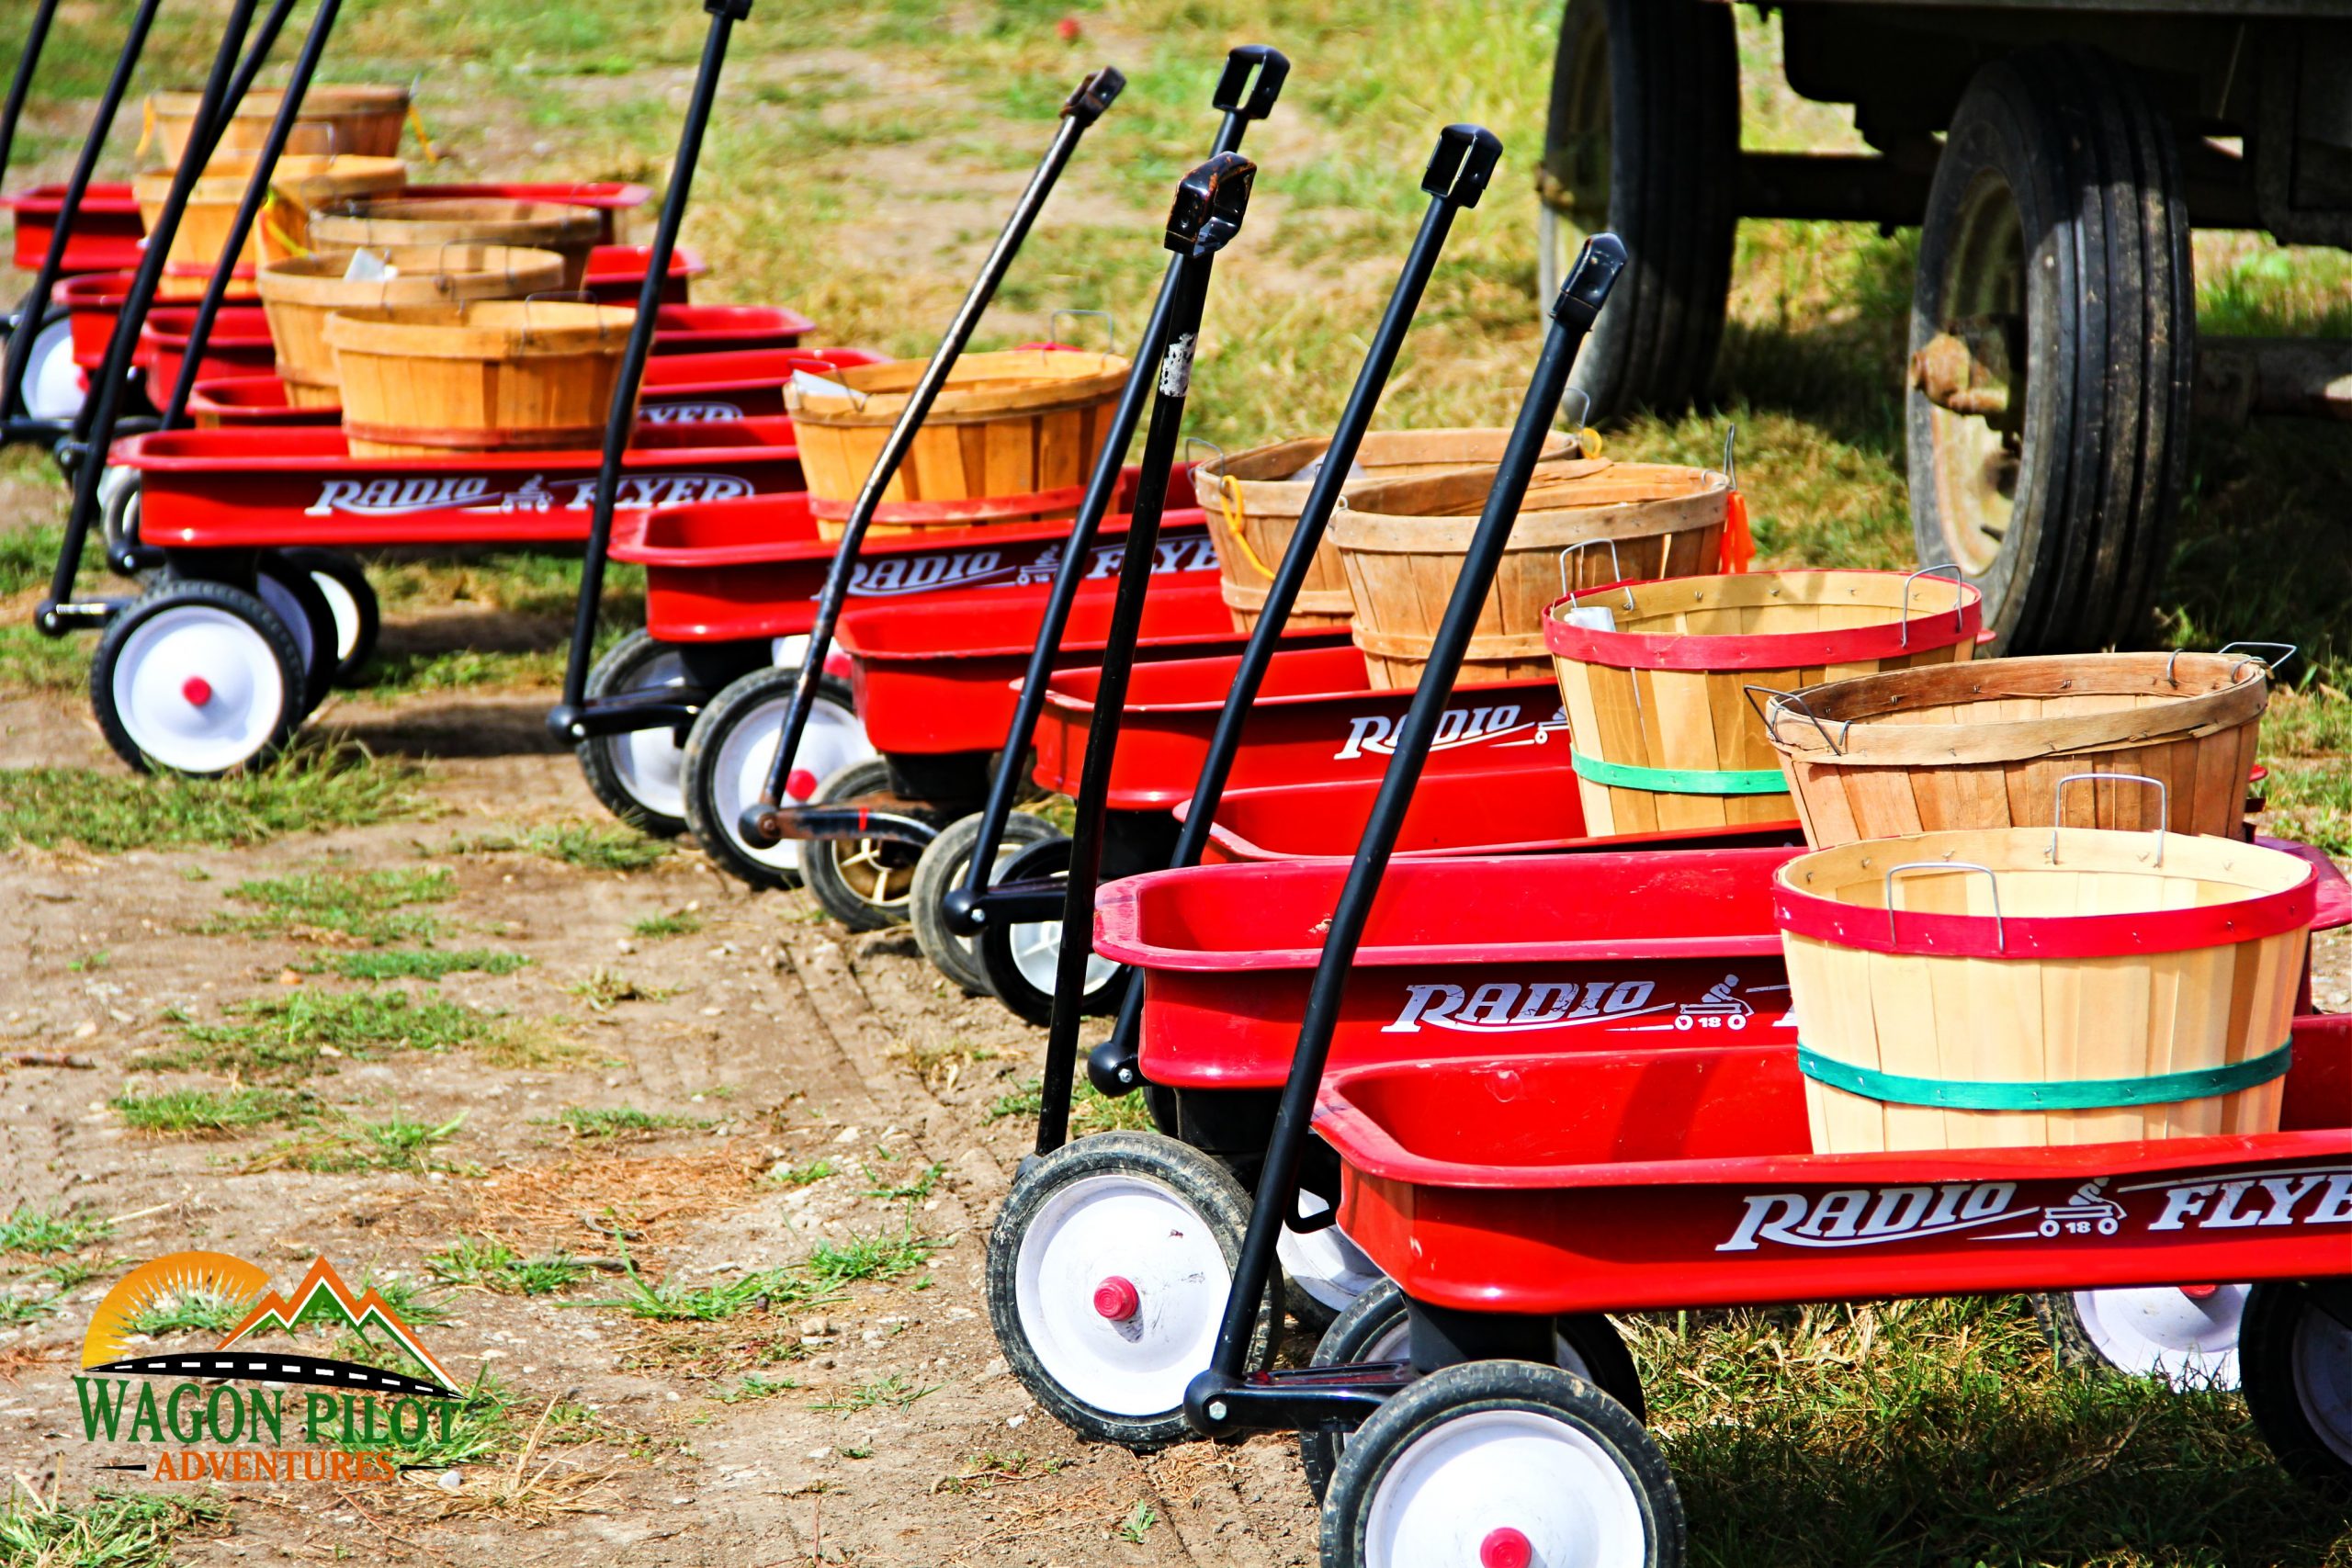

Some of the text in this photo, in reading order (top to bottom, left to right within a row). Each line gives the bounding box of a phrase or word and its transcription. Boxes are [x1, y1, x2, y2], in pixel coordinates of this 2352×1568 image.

[304, 478, 490, 515] RADIO
[1086, 540, 1220, 579] FYE
[1381, 980, 1656, 1032] RADIO
[1698, 1016, 1722, 1028] 18
[1715, 1175, 2352, 1251] RADIO FLYE
[2065, 1221, 2091, 1234] 18
